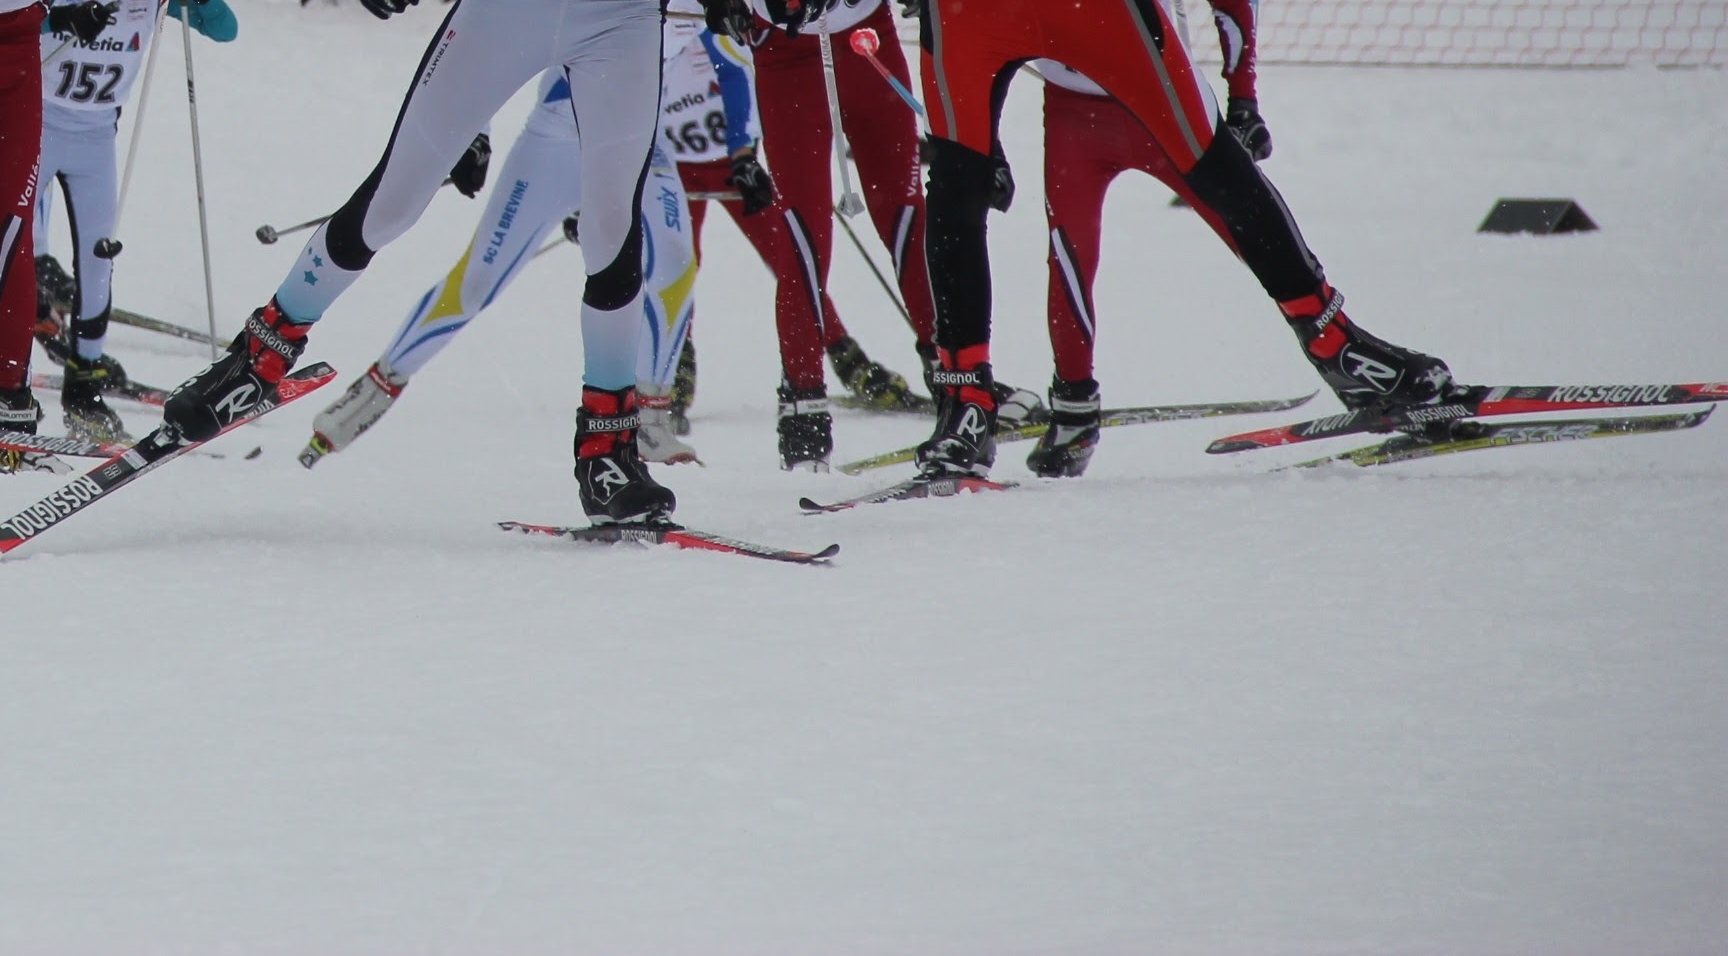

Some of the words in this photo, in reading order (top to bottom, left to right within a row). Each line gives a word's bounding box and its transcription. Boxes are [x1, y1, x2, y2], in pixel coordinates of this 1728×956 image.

[422, 42, 451, 86] TRIMTEX
[54, 59, 124, 104] 152
[664, 94, 705, 114] vetia
[664, 110, 727, 154] 168
[500, 179, 529, 231] BREVINE
[490, 230, 506, 248] LA
[483, 247, 498, 265] SC
[1315, 289, 1345, 330] ROSSIG
[1547, 384, 1672, 403] ROSSIGNOL
[588, 416, 641, 430] ROSSIGNO
[1406, 404, 1474, 424] ROSSIGNOL
[0, 475, 104, 539] ROSSIGNOL
